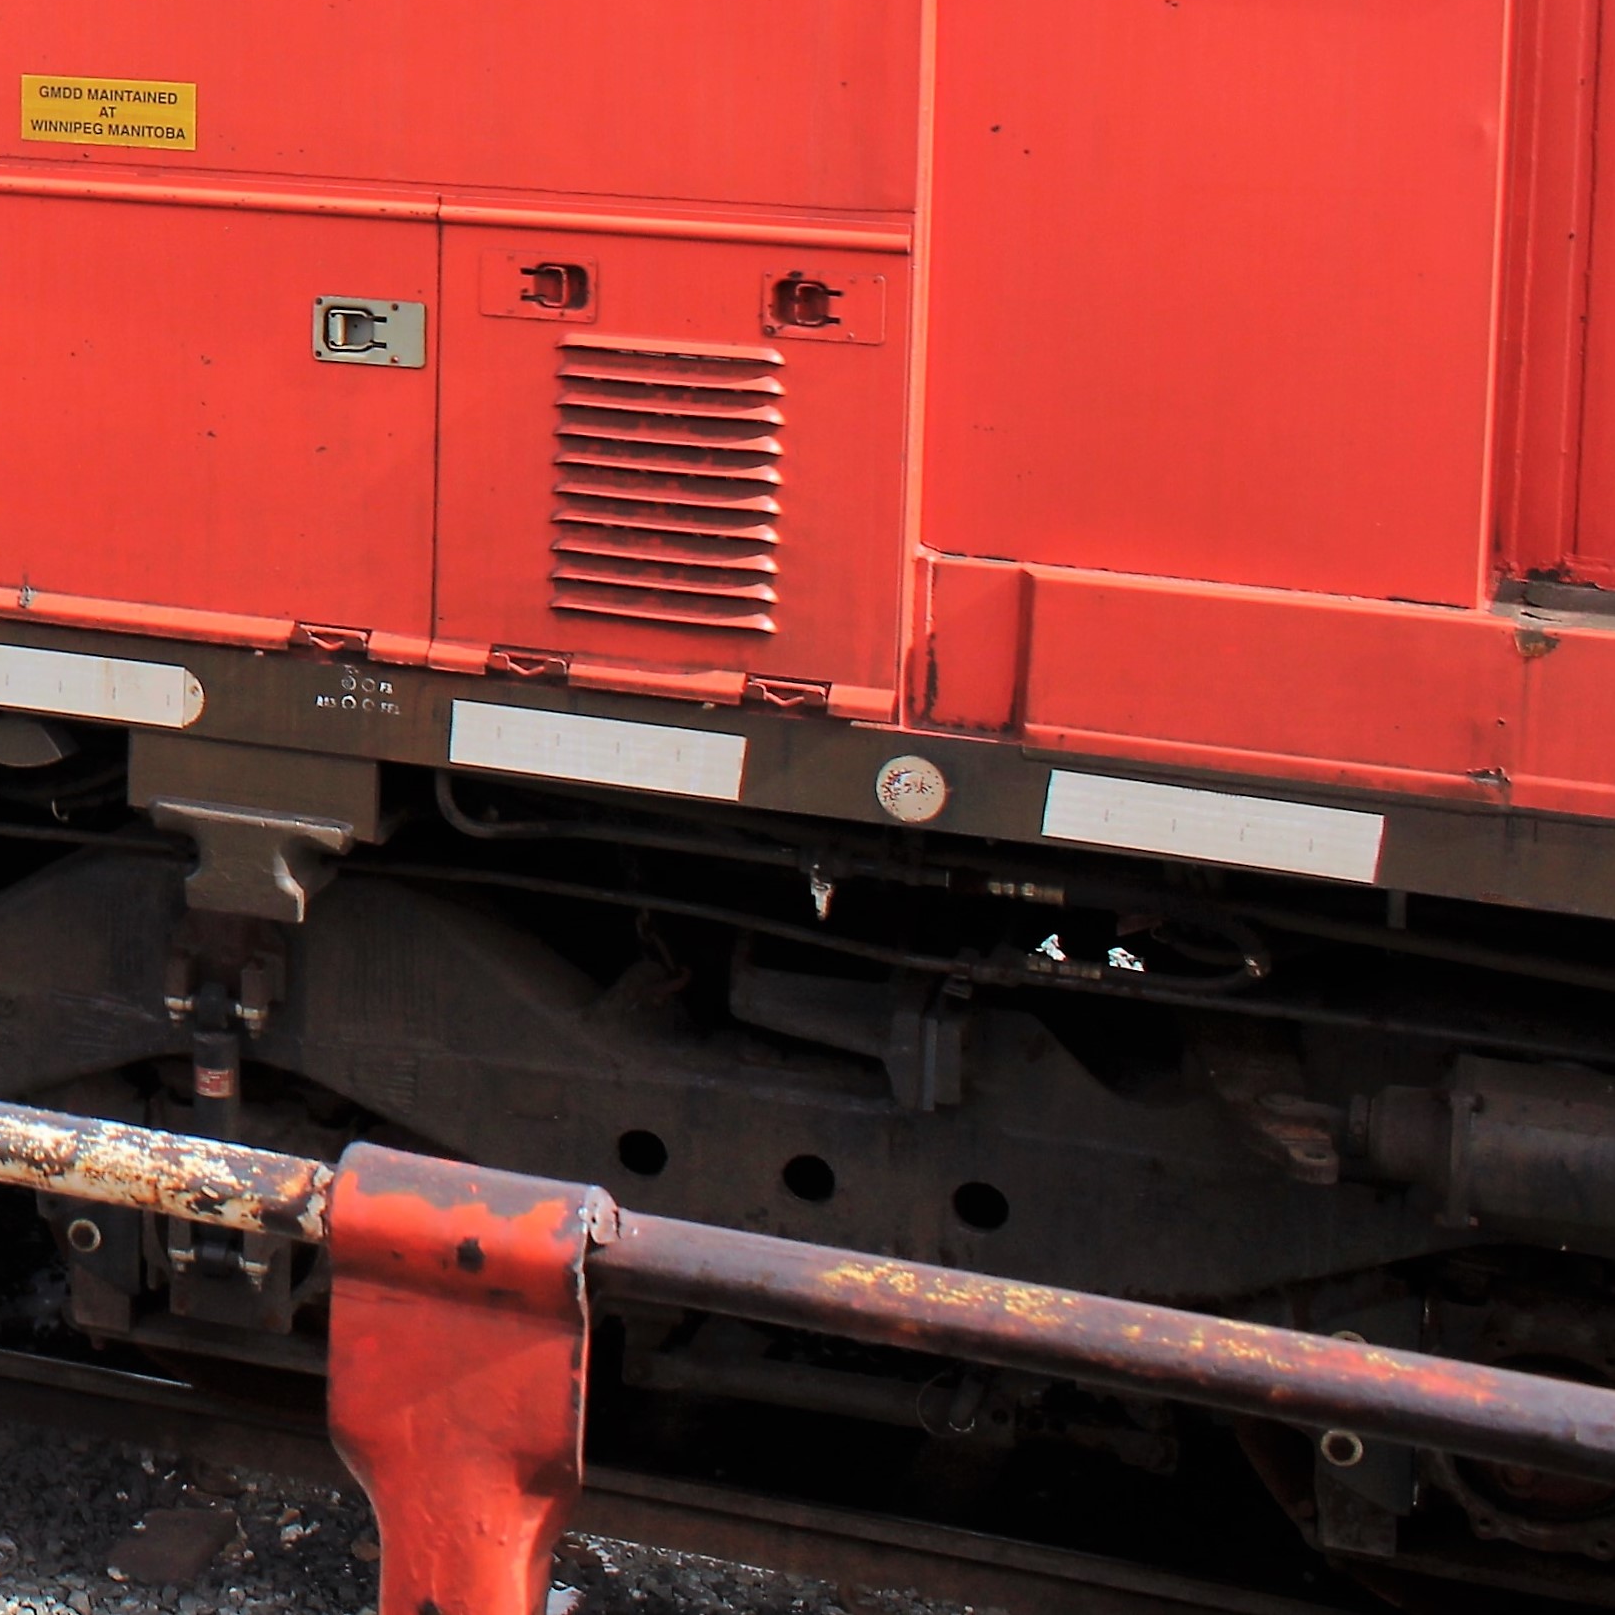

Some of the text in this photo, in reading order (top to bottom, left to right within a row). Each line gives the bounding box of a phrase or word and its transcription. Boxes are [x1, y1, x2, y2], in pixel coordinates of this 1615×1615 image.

[39, 85, 178, 105] GMDD MAINTAINED
[99, 106, 117, 118] AT
[30, 119, 186, 139] WINNIPEG MANITOBA
